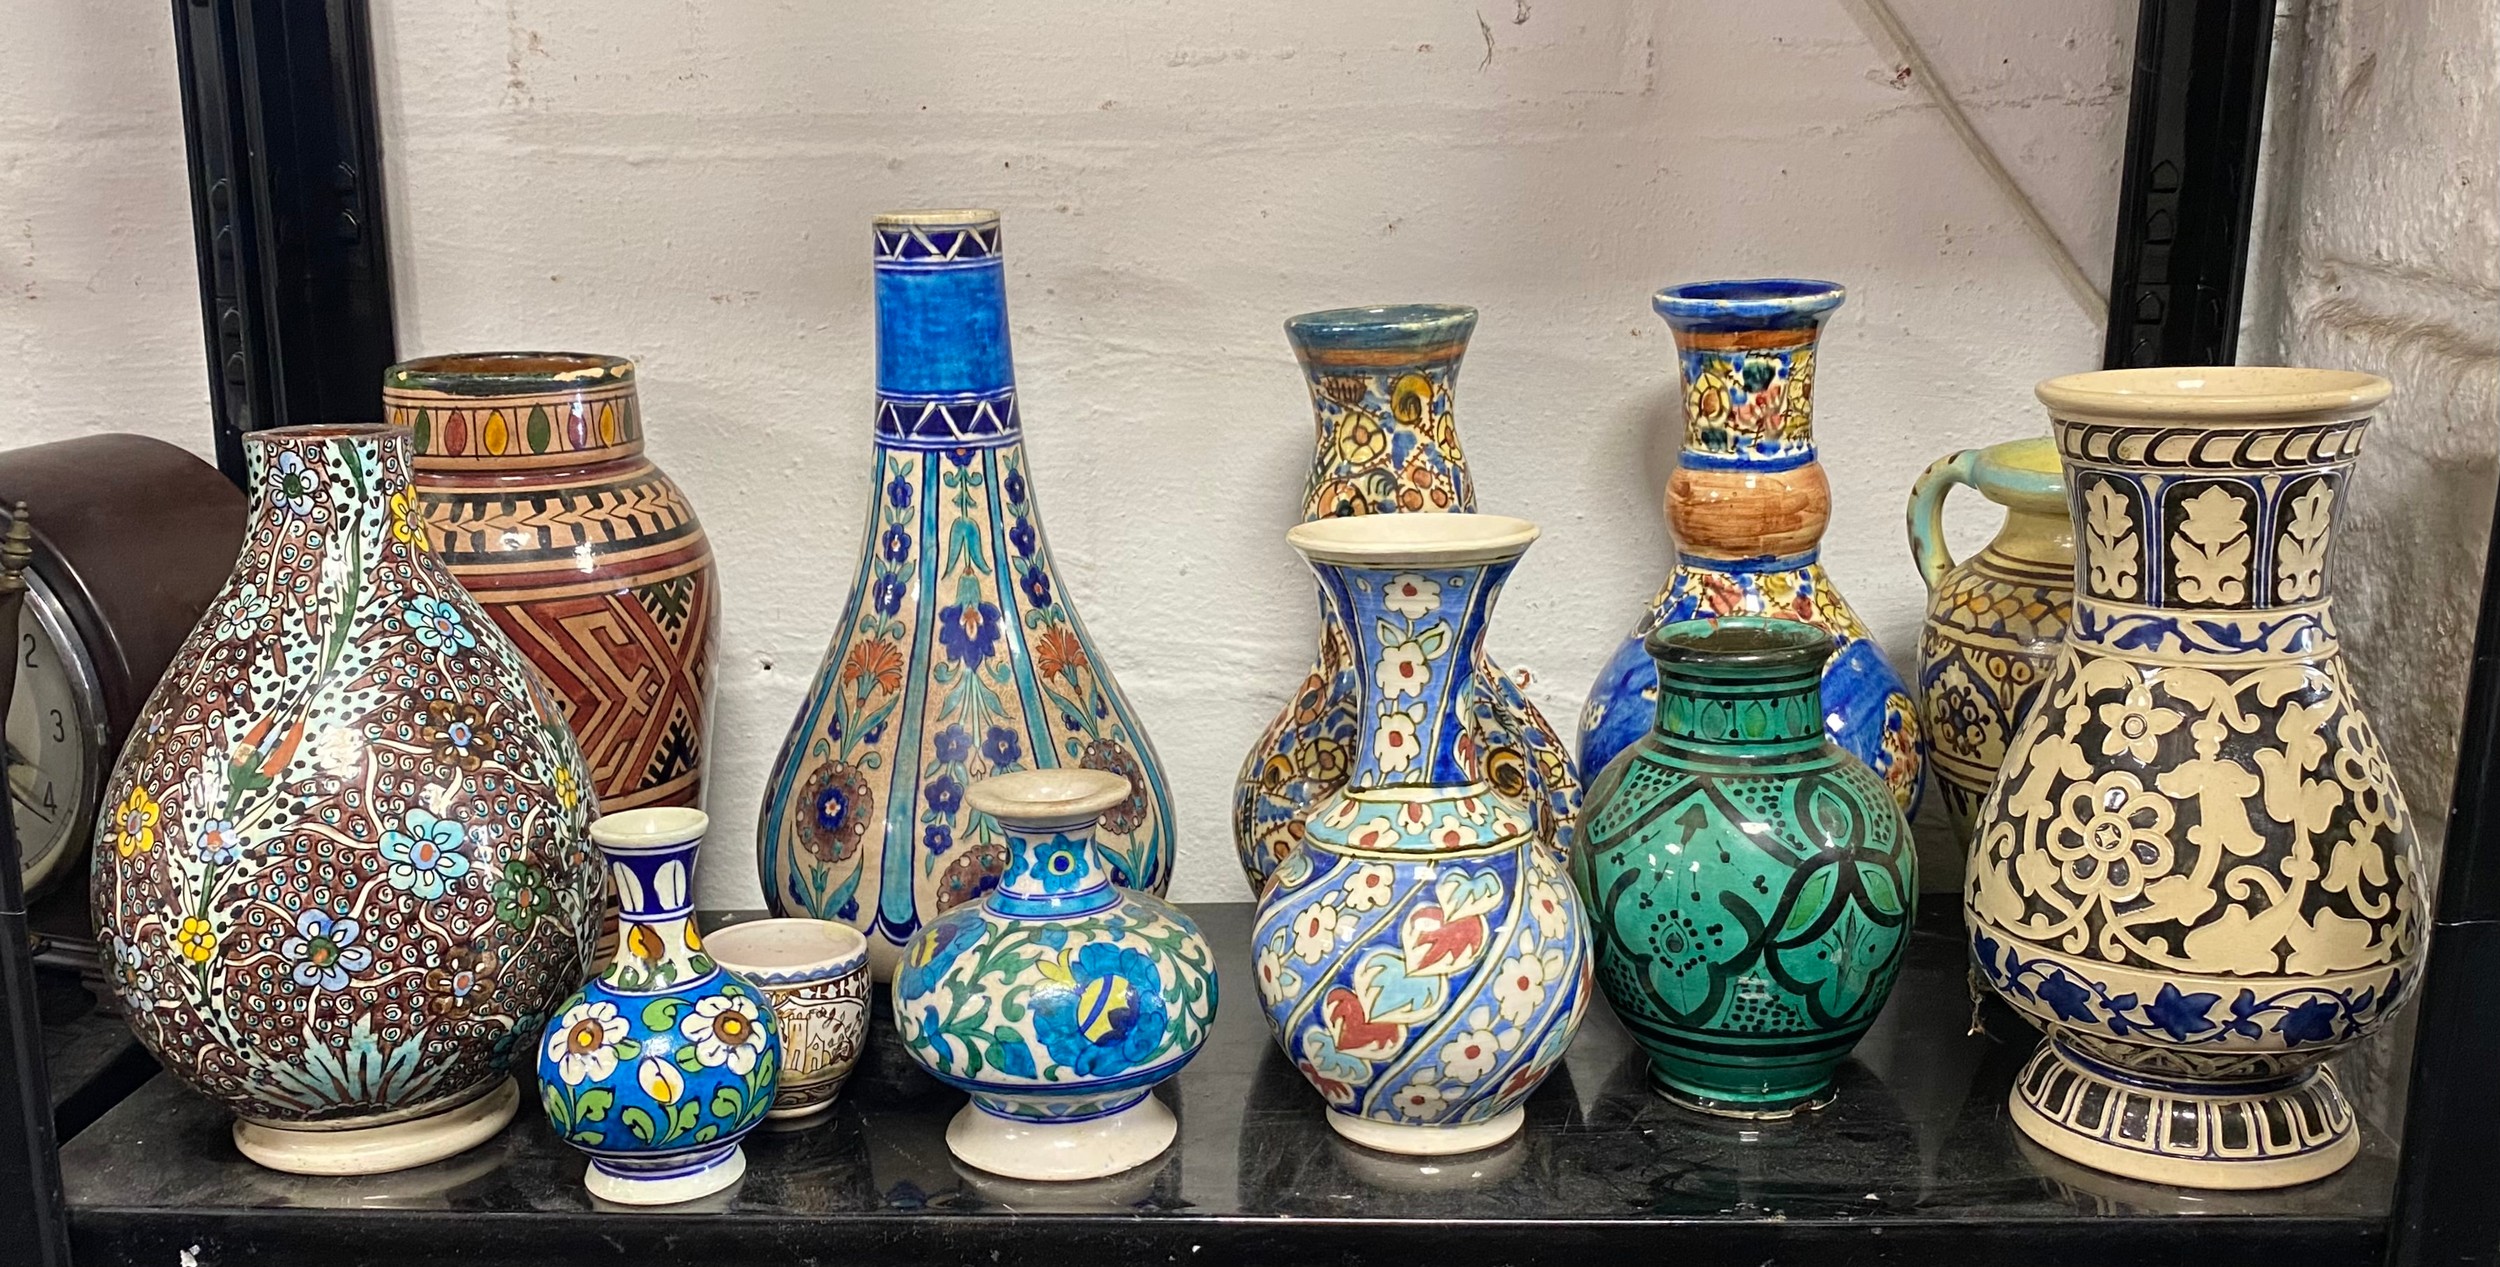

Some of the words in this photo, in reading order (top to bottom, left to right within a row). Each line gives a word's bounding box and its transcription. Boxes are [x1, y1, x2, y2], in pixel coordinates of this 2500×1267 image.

[23, 633, 38, 668] 2
[50, 709, 65, 743] 3
[43, 781, 57, 815] 4
